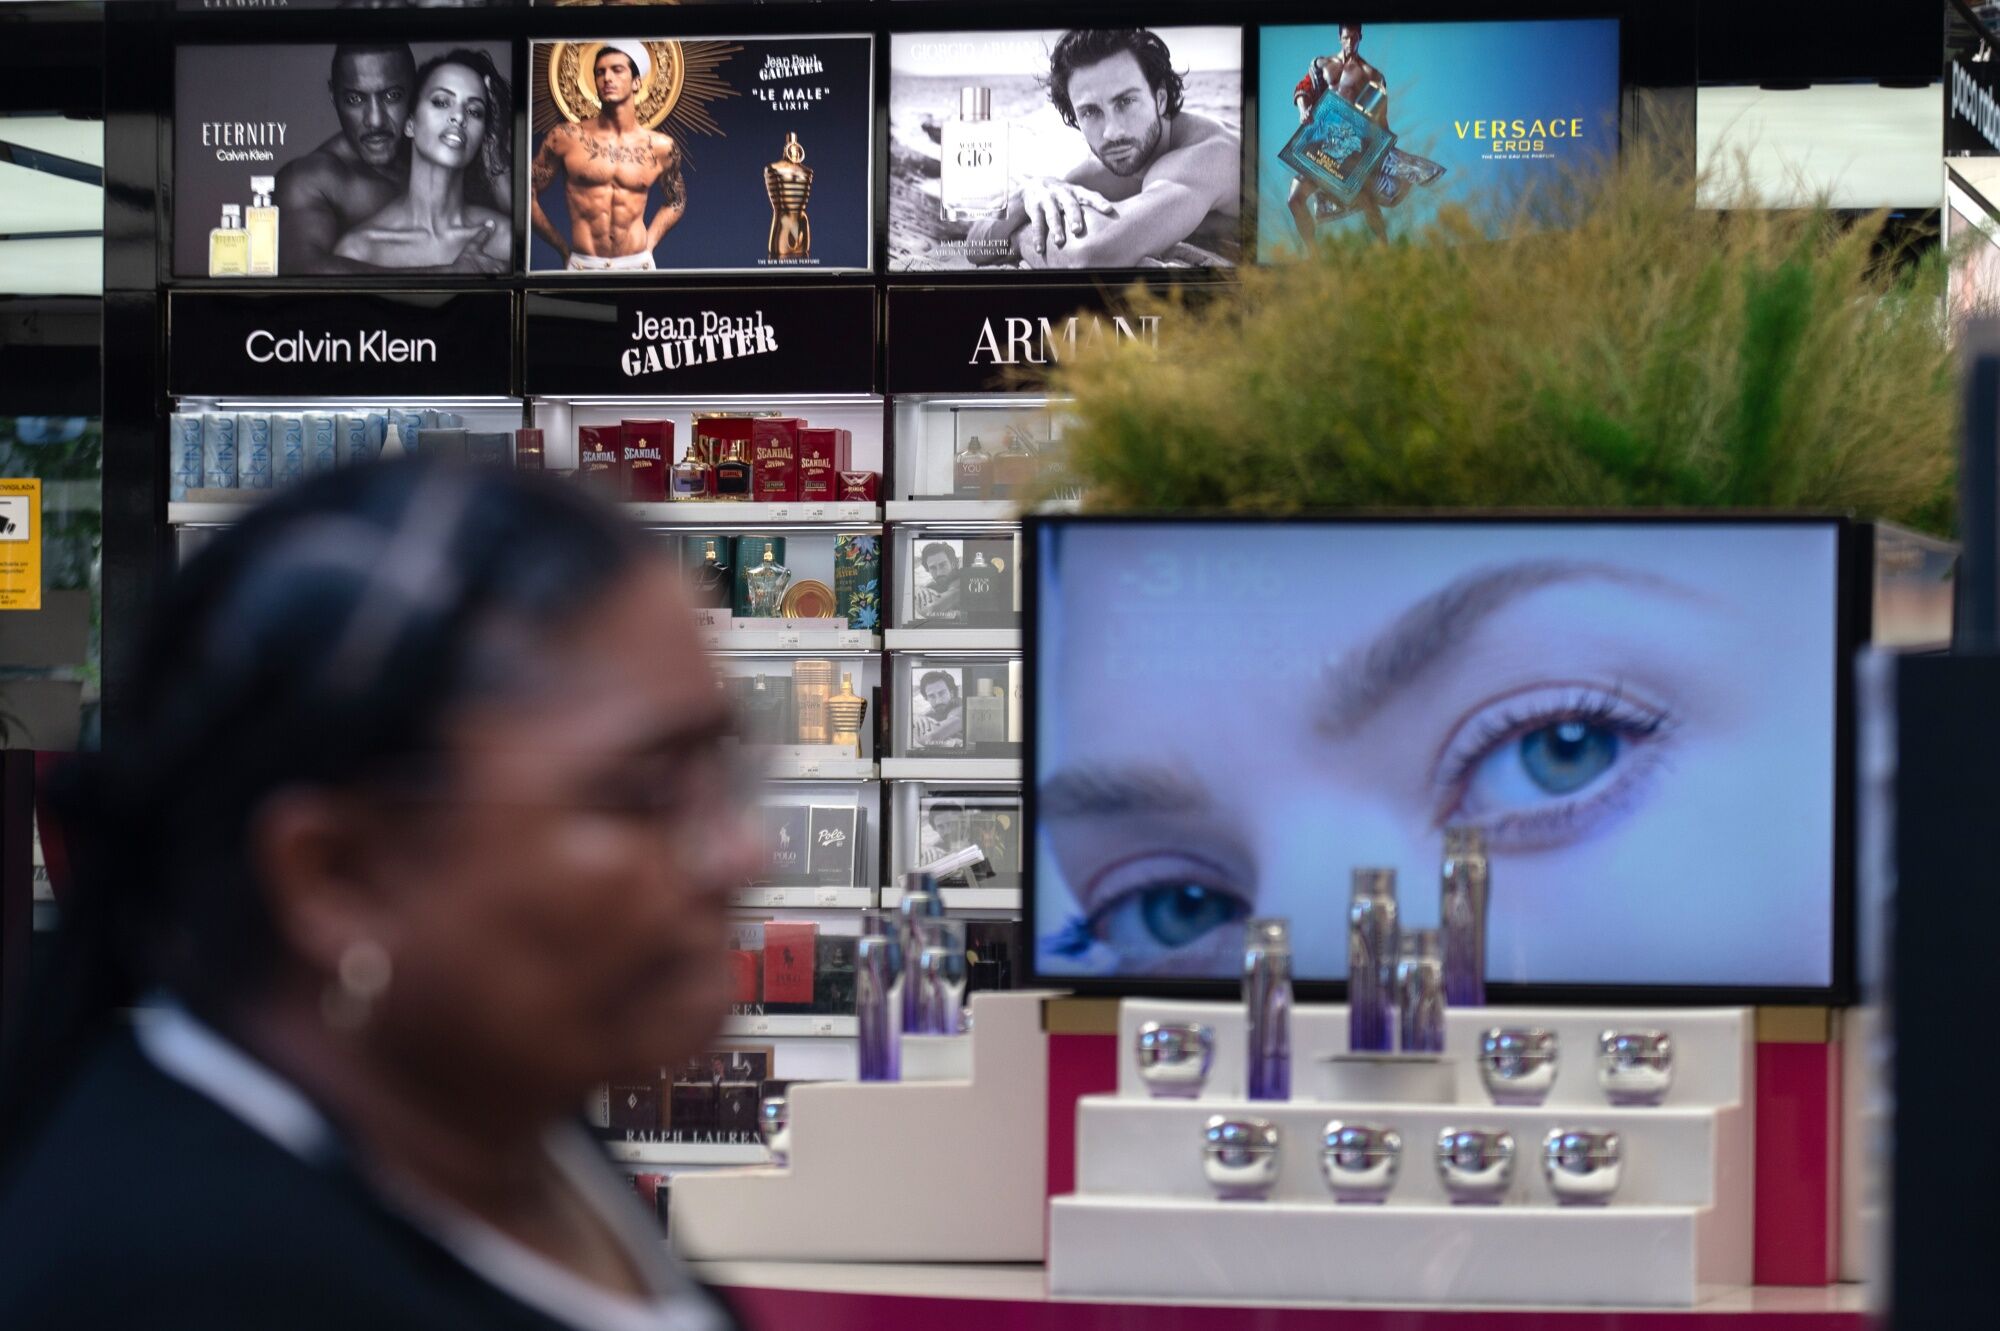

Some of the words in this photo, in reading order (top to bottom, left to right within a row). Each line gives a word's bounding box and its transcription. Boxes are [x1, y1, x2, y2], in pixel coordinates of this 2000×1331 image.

[1952, 59, 1978, 127] paco
[772, 101, 809, 111] ELIXIR
[202, 122, 287, 146] ETERNITY
[1454, 118, 1584, 140] VERSACE
[1492, 140, 1544, 152] EROS
[216, 148, 249, 161] Calvin
[249, 148, 274, 161] Klein
[631, 310, 698, 341] Jean
[701, 310, 764, 339] Paul
[245, 329, 351, 363] Calvin
[359, 329, 436, 363] Klein
[968, 315, 1162, 365] ARMANI
[621, 324, 779, 377] GAULTIER
[582, 450, 617, 463] SCANDAL
[624, 446, 662, 461] SCANDAL
[756, 446, 794, 460] SCANDAL
[801, 457, 832, 469] SCANDAL
[962, 463, 982, 473] YOU
[818, 828, 846, 843] Polo
[732, 1003, 765, 1016] REN
[626, 1129, 684, 1144] RALPH
[692, 1129, 762, 1145] LAUREN
